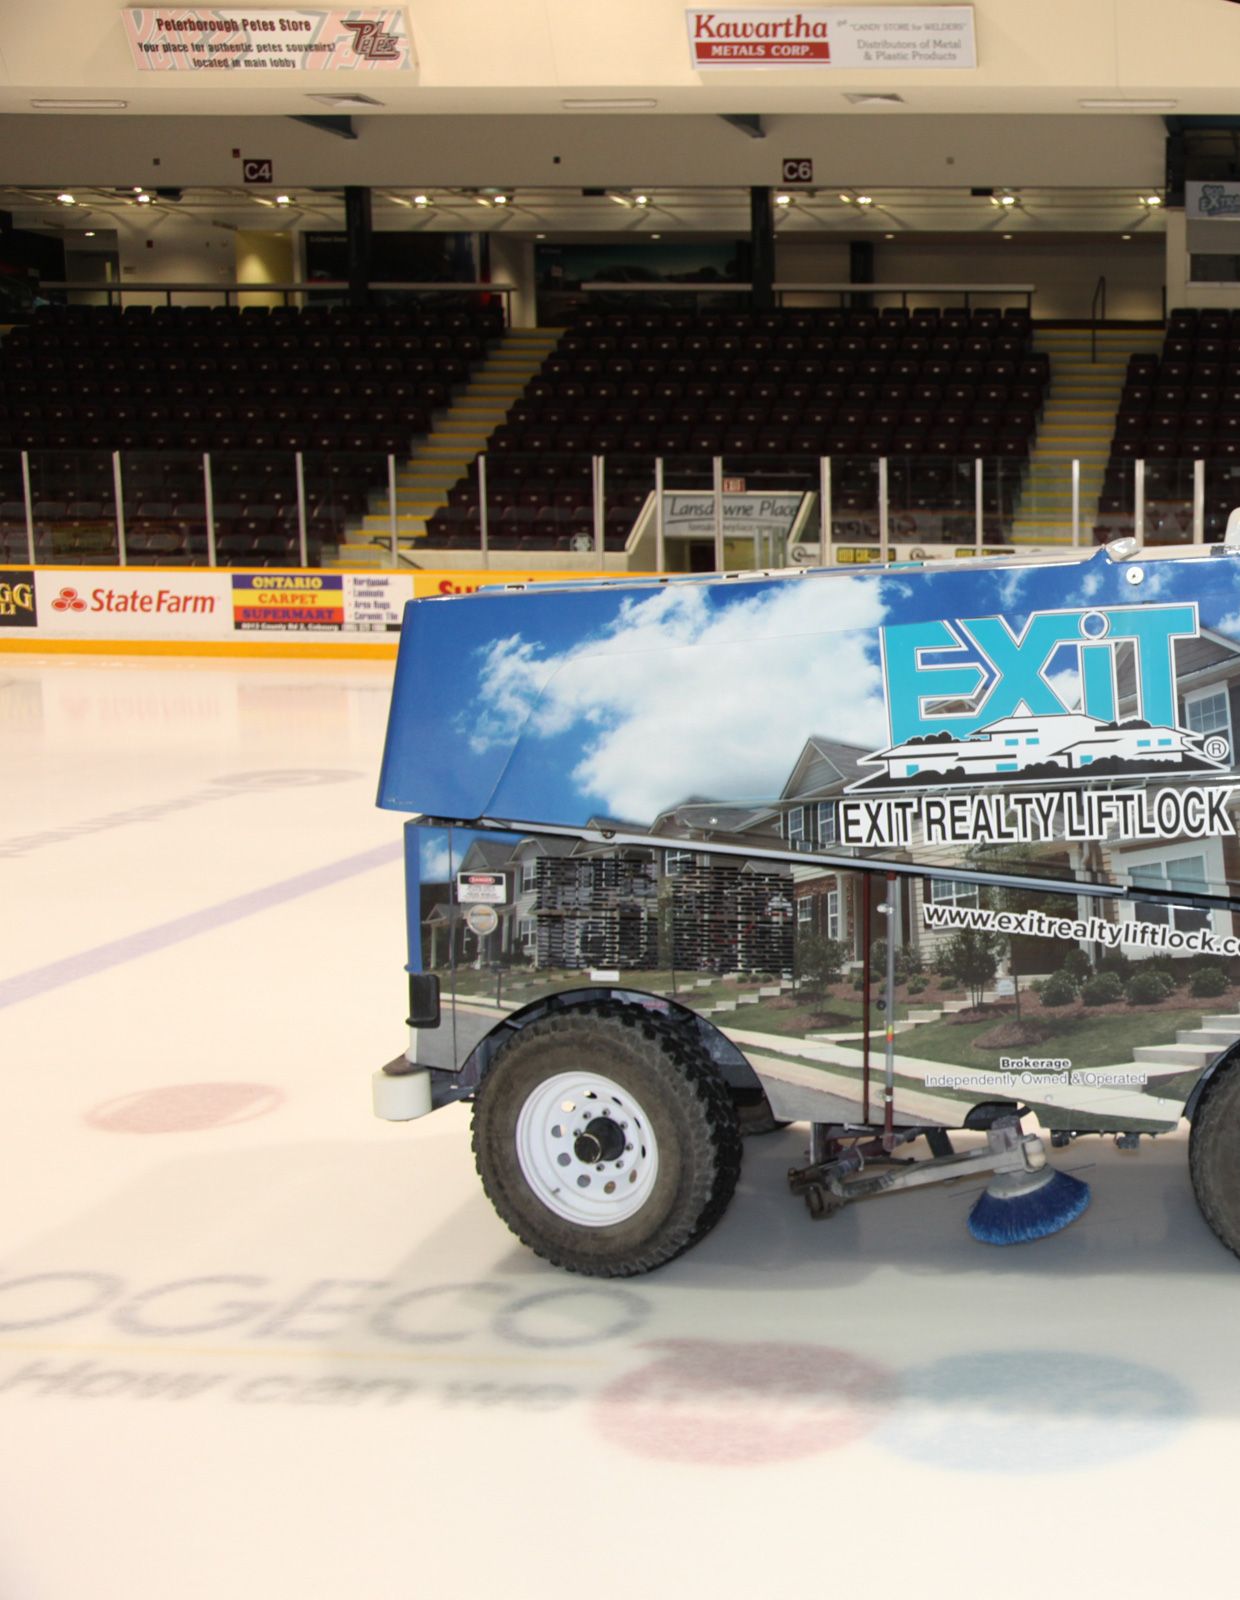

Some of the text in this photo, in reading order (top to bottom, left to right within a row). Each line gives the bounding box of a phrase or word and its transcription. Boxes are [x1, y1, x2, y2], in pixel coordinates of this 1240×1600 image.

[156, 18, 311, 32] Peterborough Petes Store
[694, 14, 828, 39] Kawartha
[137, 42, 159, 52] Your
[163, 42, 189, 54] place
[191, 42, 205, 52] for
[208, 42, 254, 52] authentic
[256, 43, 283, 54] petes
[857, 39, 962, 49] Distributors of Metal
[711, 45, 814, 57] METALS CORP.
[875, 51, 909, 60] Plastic
[911, 51, 958, 61] Products
[192, 58, 230, 68] located
[244, 58, 267, 68] main
[270, 57, 297, 69] lobby
[244, 161, 272, 181] C4
[783, 161, 812, 180] C6
[670, 498, 753, 516] Lansdwne
[252, 576, 324, 589] ONTARIO
[91, 588, 216, 614] State Farm
[258, 593, 318, 605] CARPET
[242, 609, 334, 620] SUPERMART
[840, 786, 1236, 847] EXIT REALTY LIFTLOCK
[1000, 1057, 1071, 1070] Brokerage
[925, 1071, 1147, 1087] Independently Owned & Operated
[0, 1357, 232, 1402] How
[235, 1372, 422, 1406] can
